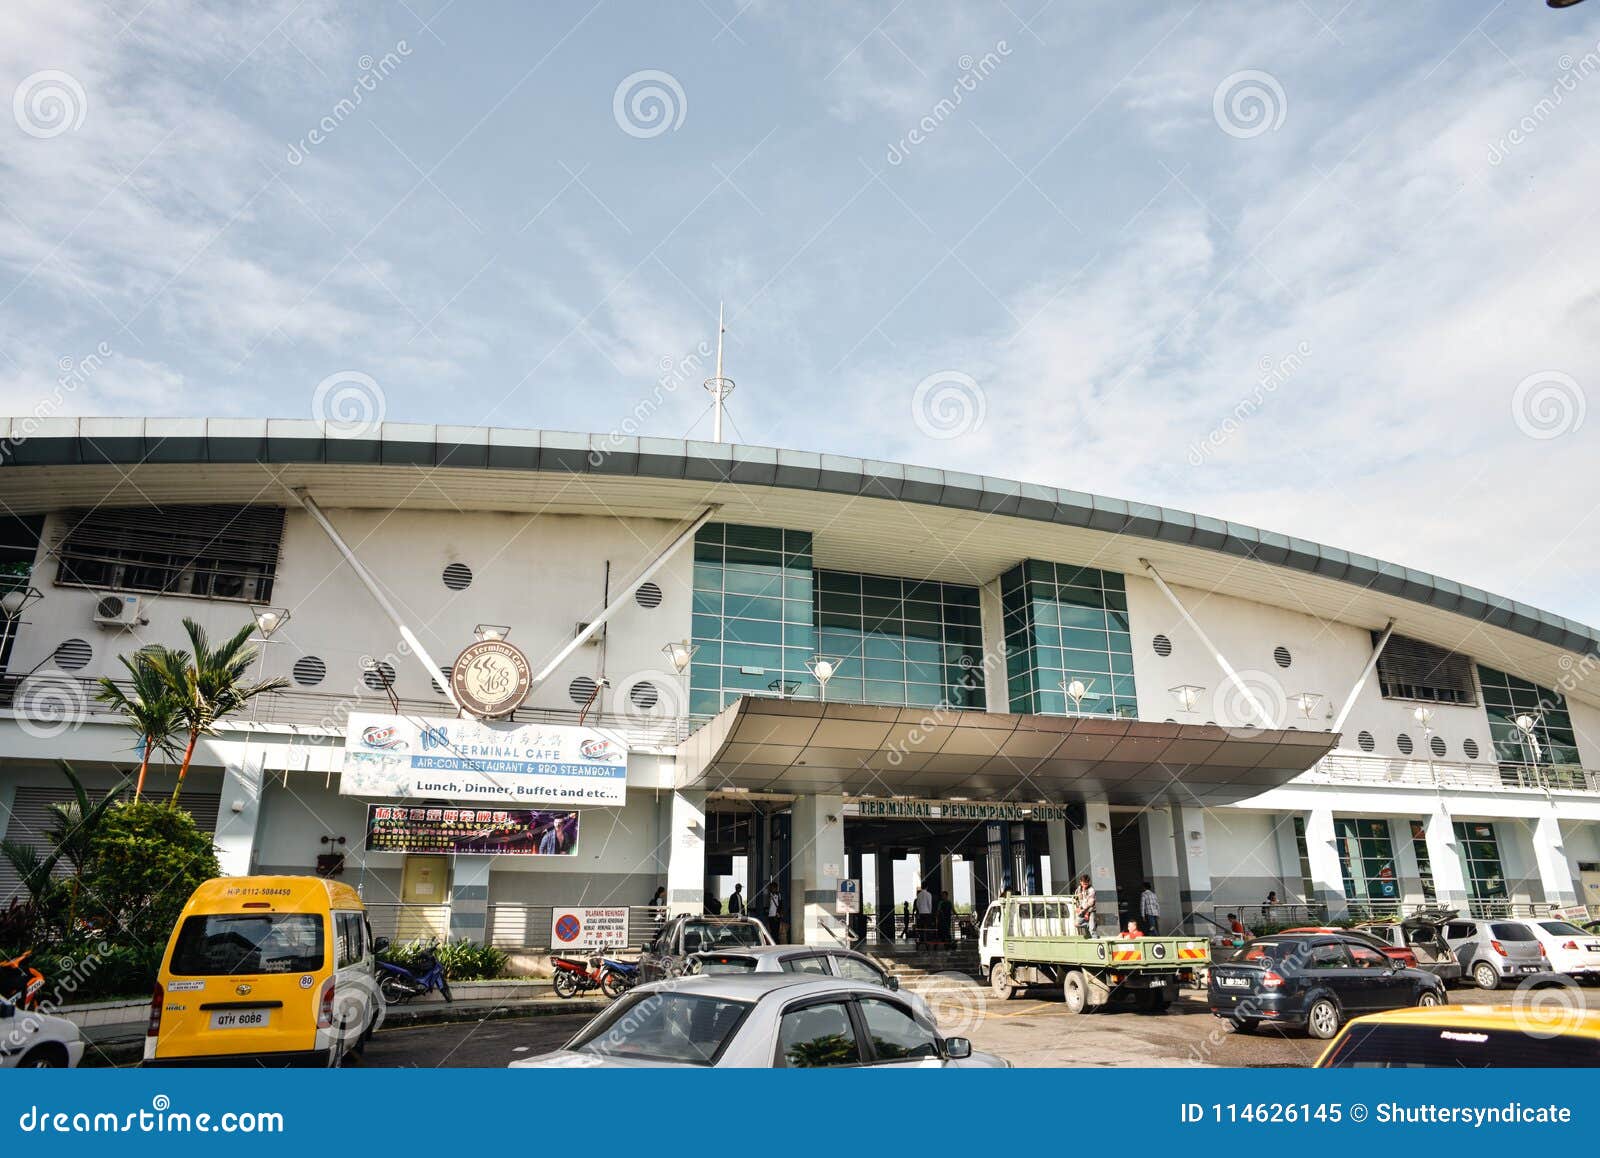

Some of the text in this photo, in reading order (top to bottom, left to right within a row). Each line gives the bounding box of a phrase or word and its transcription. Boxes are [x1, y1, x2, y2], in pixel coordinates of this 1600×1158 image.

[420, 726, 450, 751] 168
[453, 744, 560, 760] TERMINAL CAFE
[417, 759, 458, 769] AIR-CON
[462, 761, 523, 771] RESTAURANT
[560, 766, 616, 777] STEAMBOAT
[417, 781, 618, 799] Lunch, Dinner, Buffet and etc...
[860, 801, 1064, 820] TERMINAL PENUMPANG SIBU
